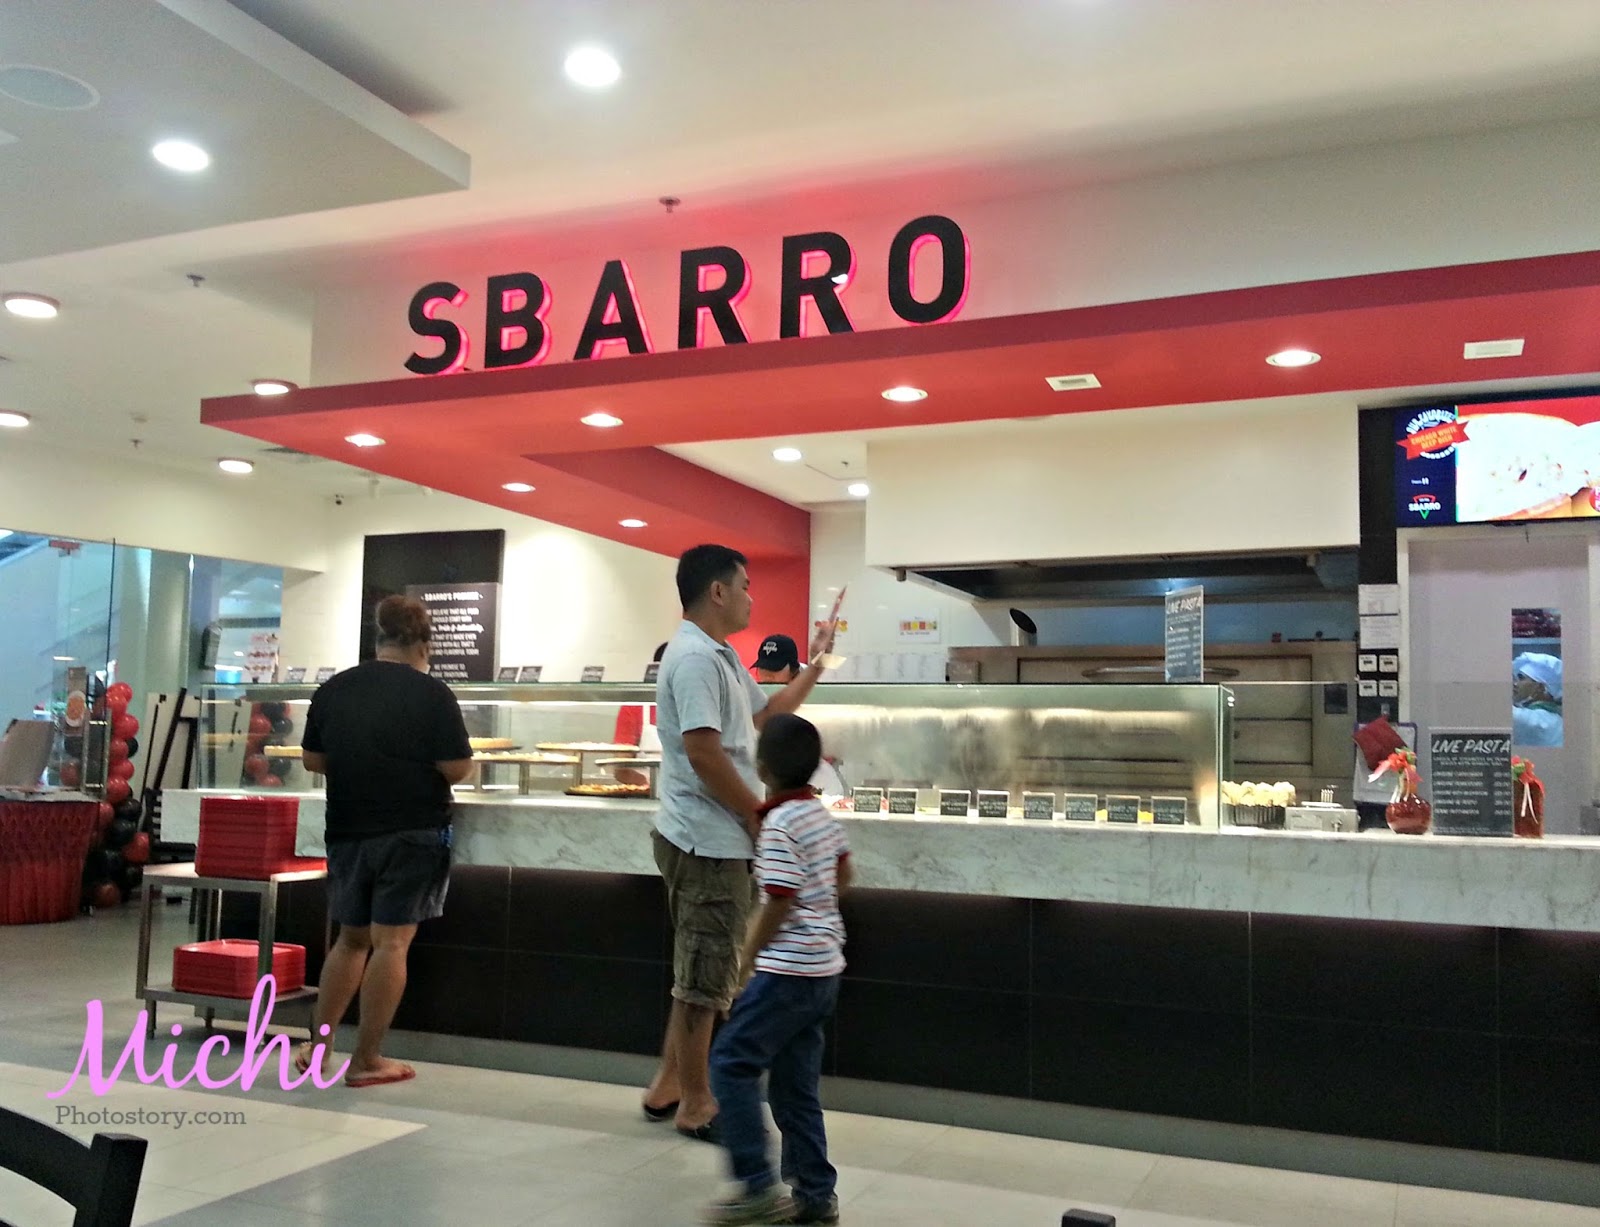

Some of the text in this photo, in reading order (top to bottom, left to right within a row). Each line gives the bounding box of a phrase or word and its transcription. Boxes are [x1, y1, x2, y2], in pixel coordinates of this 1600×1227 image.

[404, 214, 970, 375] SBARRO
[1408, 502, 1441, 511] SBARRO
[1432, 739, 1511, 754] LIVE PASTA
